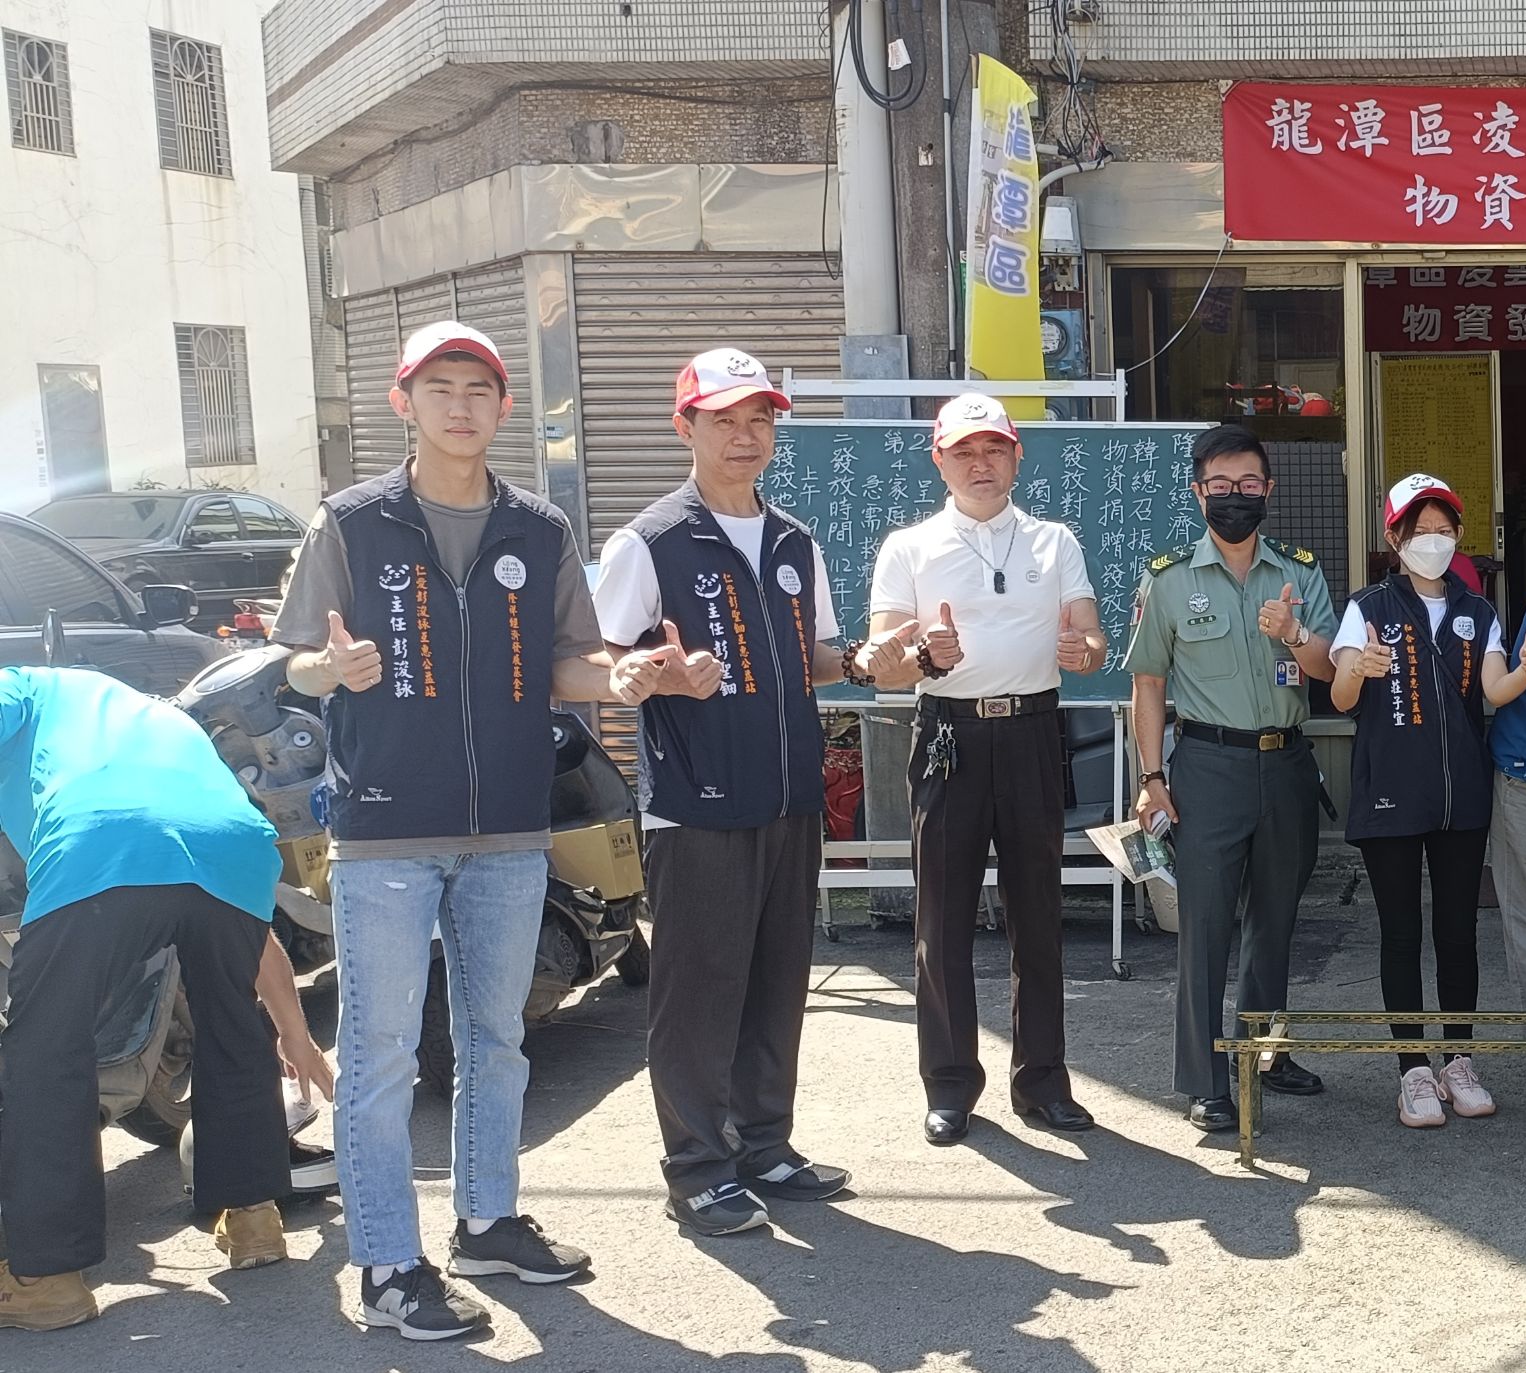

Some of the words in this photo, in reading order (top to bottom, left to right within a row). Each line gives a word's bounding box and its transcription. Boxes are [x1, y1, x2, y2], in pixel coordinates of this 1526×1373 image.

[1098, 439, 1129, 676] 物資捐贈發放活動
